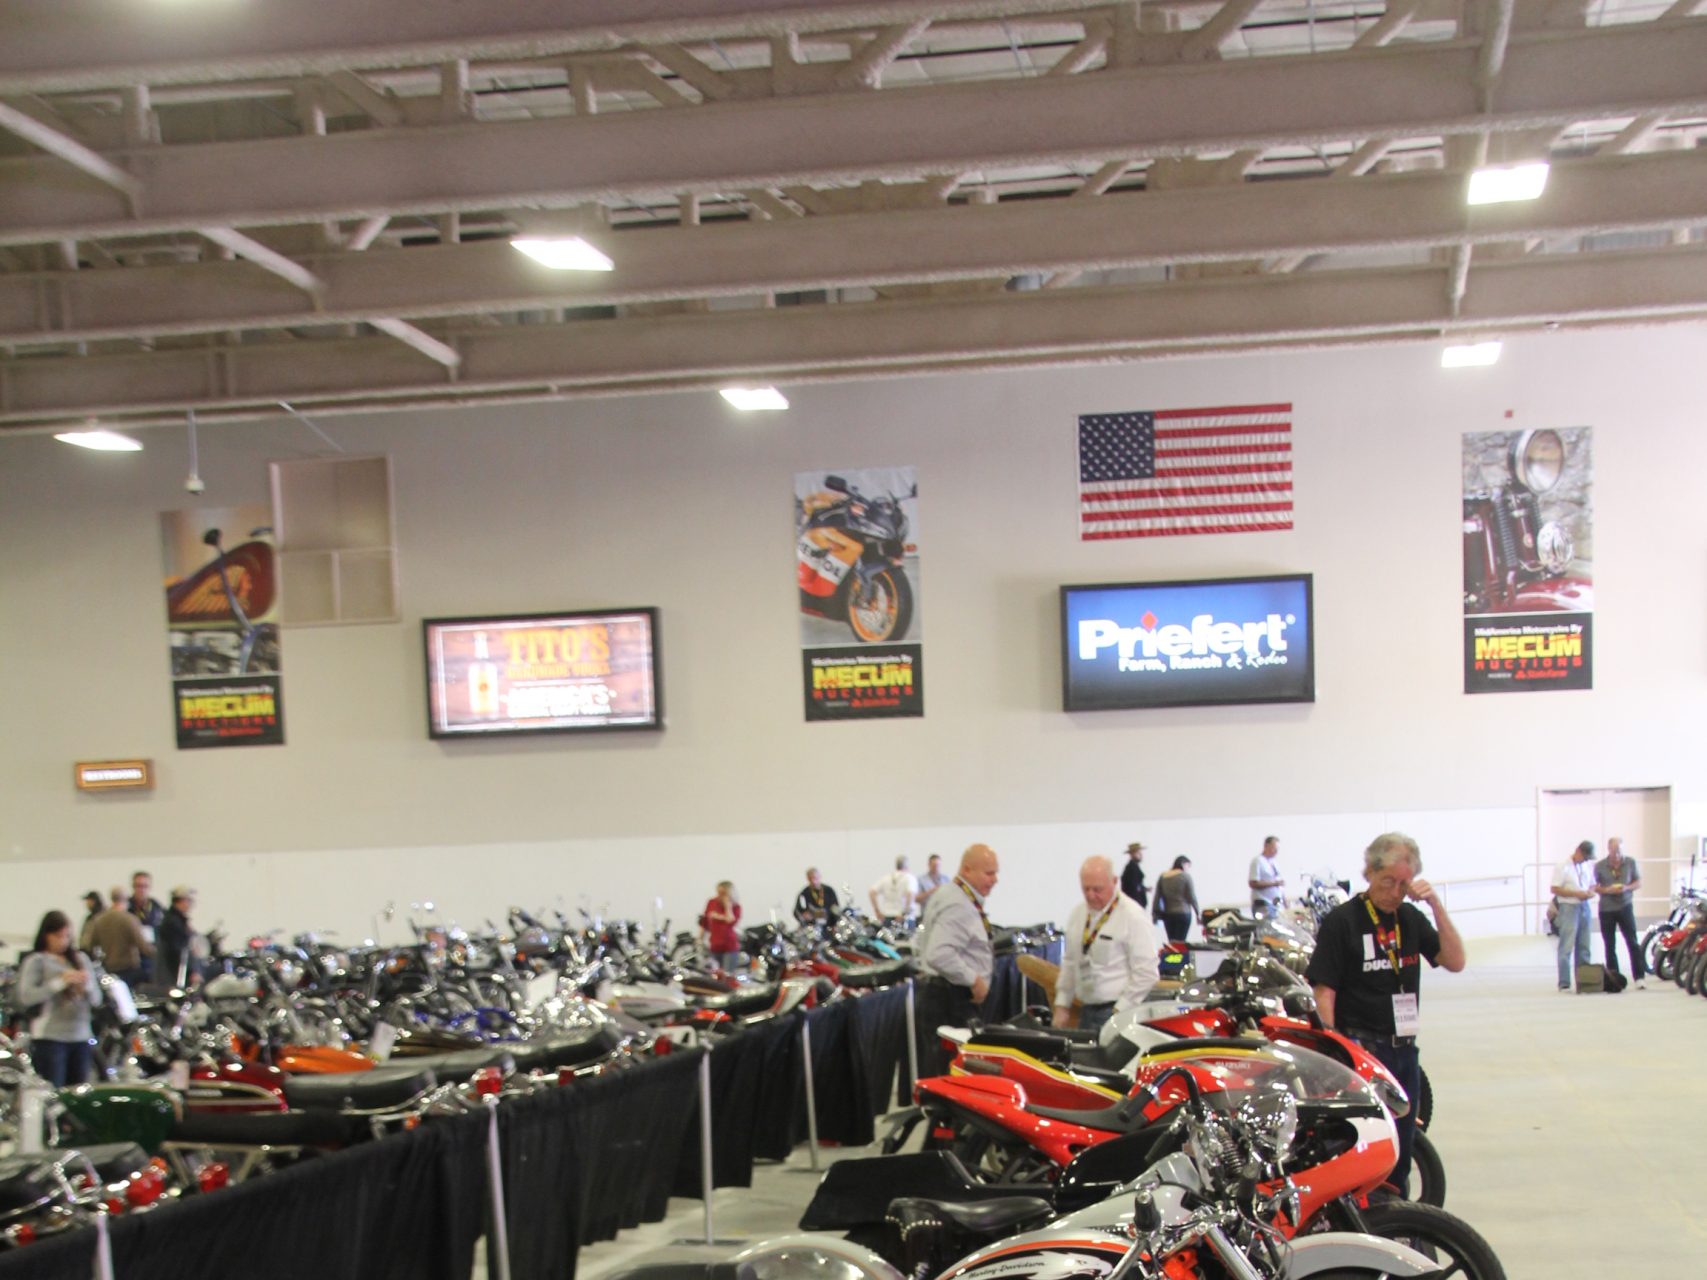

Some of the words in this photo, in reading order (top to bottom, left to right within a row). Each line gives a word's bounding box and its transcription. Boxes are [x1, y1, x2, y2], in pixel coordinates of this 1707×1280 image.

[503, 625, 609, 664] TITO'S
[1078, 611, 1288, 660] Priefert
[1475, 633, 1582, 660] MECUM
[1117, 656, 1167, 673] Farm,
[1169, 653, 1223, 670] Ranch
[1245, 649, 1289, 669] Rodeo
[812, 662, 913, 689] MECUM
[181, 693, 276, 719] MECUM
